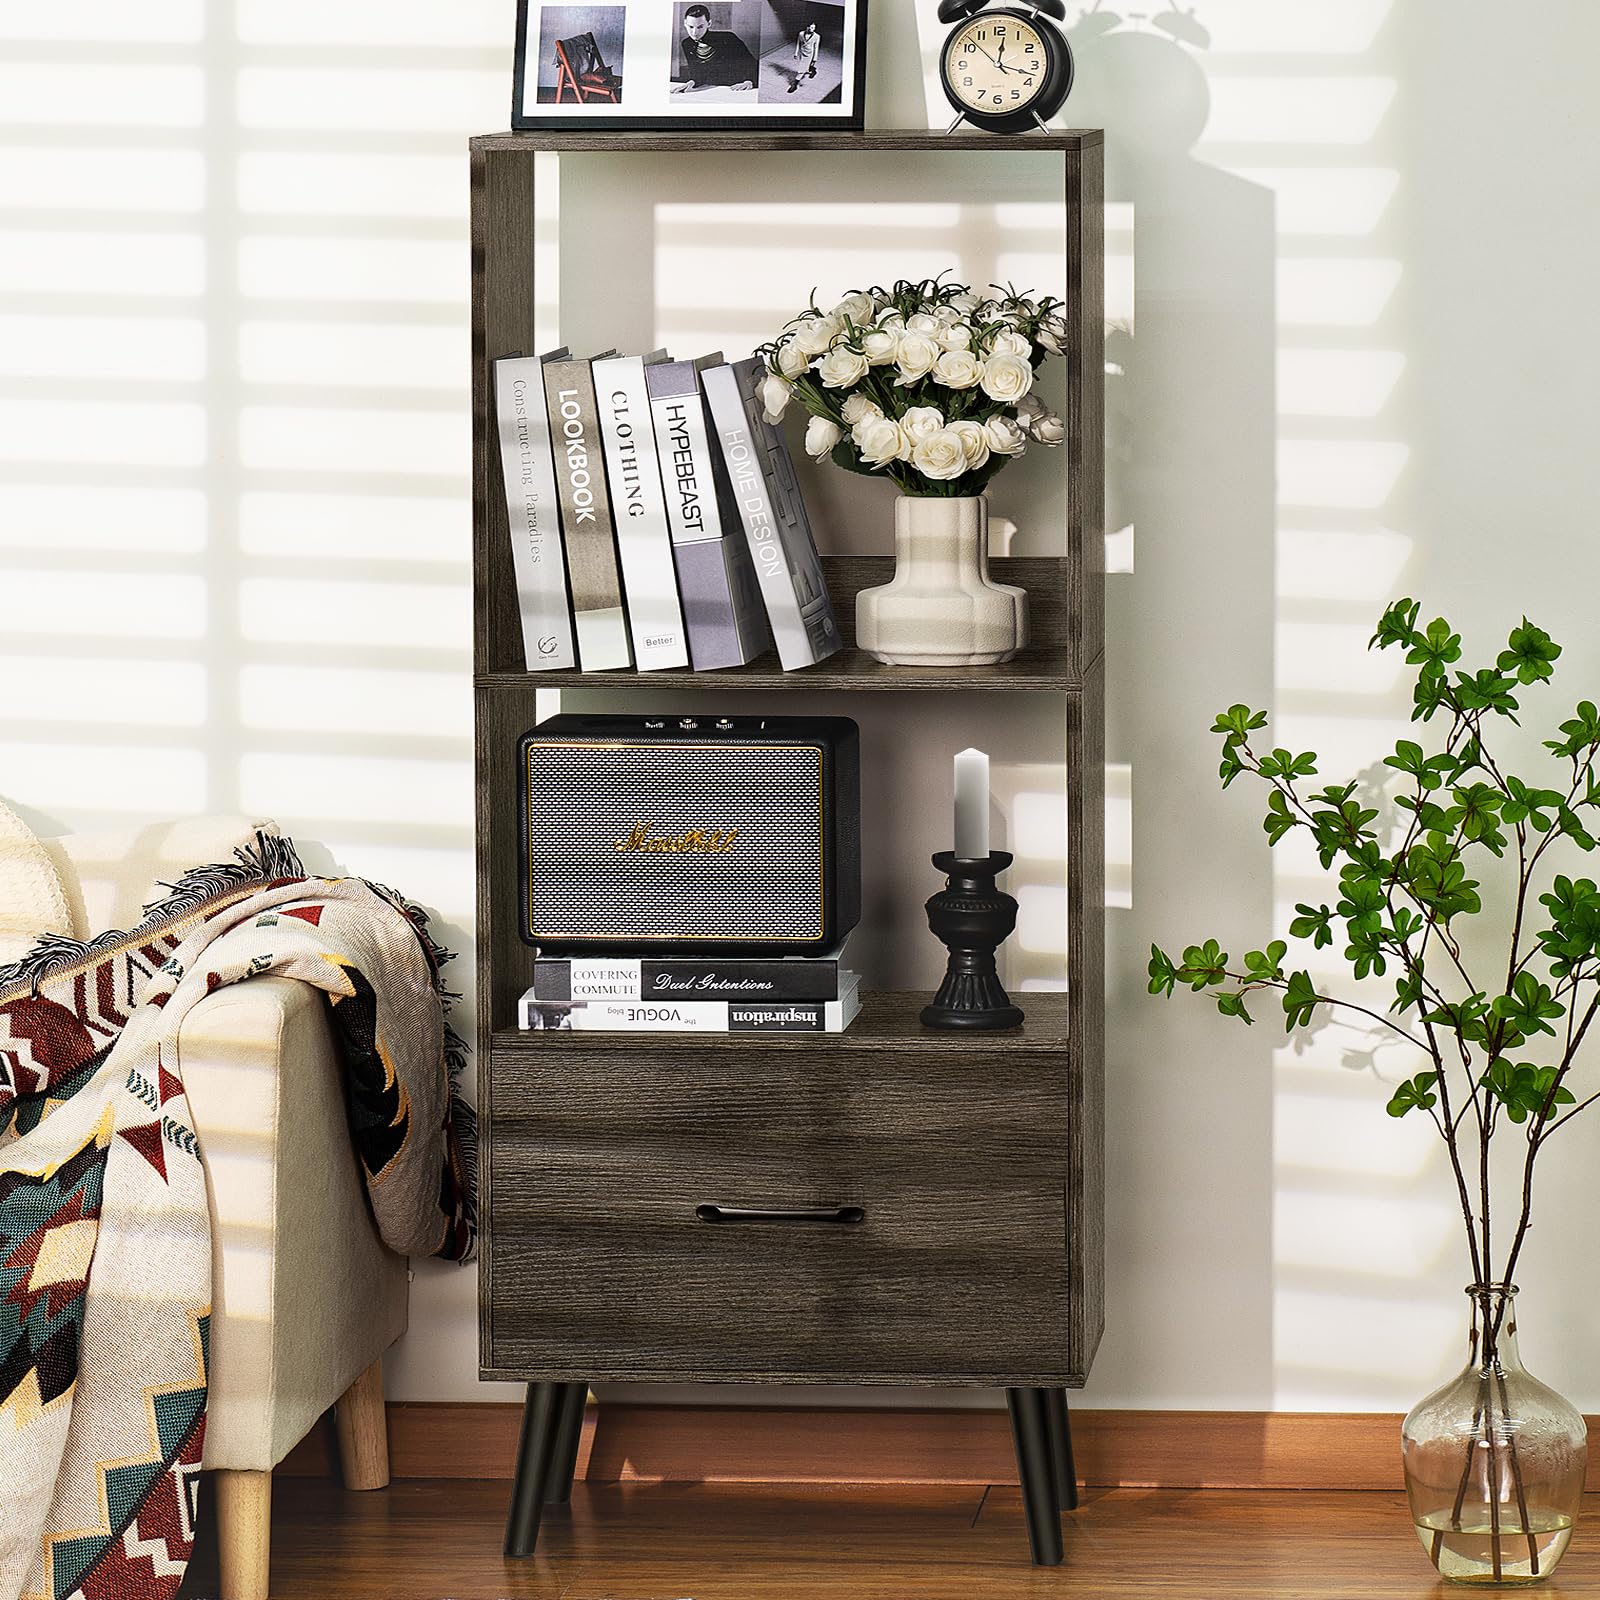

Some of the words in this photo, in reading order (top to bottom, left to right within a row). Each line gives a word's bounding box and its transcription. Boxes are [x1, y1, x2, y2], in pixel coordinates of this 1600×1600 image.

[977, 30, 986, 41] 11
[994, 26, 1006, 36] 12
[963, 43, 976, 54] 10
[1024, 43, 1034, 54] 2
[958, 60, 968, 70] 9
[1031, 60, 1039, 70] 3
[963, 76, 973, 87] 8
[1023, 77, 1033, 87] 4
[977, 89, 987, 100] 7
[993, 94, 1003, 105] 6
[1010, 89, 1020, 100] 5
[558, 389, 597, 525] LOOKBOOK
[611, 390, 645, 518] CLOTHING
[723, 428, 758, 494] HOME
[512, 379, 535, 485] Constructing
[525, 493, 544, 564] Paradies
[665, 404, 704, 534] HYPEBEAST
[645, 636, 673, 648] Better
[573, 970, 638, 981] COVERING
[652, 973, 696, 991] Duel
[573, 985, 637, 995] COMMUTE
[627, 1008, 681, 1022] VOGUE
[732, 1007, 818, 1026] inspiration
